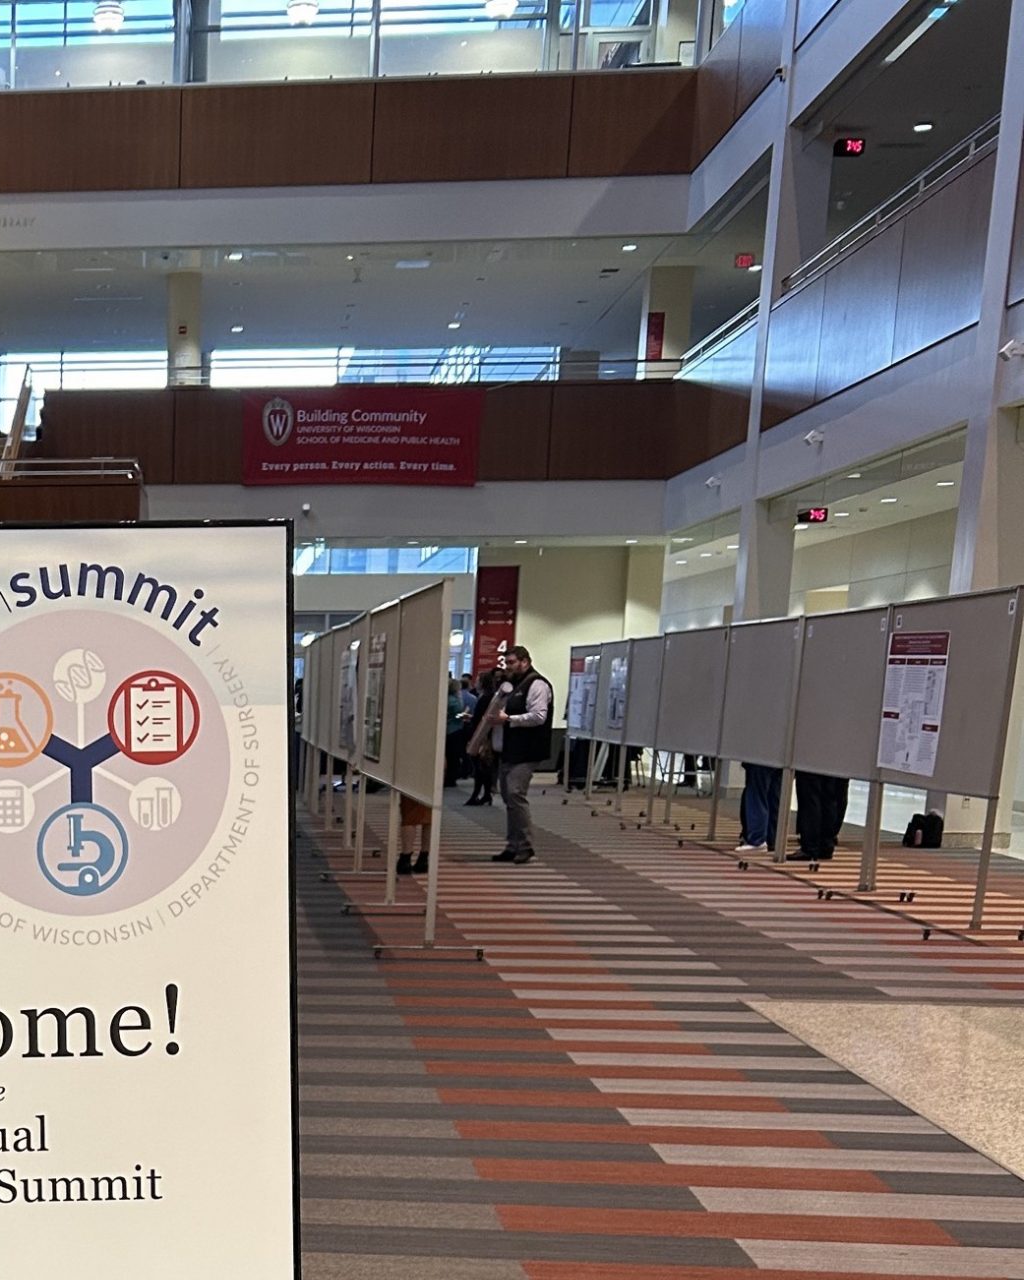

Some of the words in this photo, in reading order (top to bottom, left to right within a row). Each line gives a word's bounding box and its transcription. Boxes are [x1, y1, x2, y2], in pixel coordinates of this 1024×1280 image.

[296, 409, 349, 424] Building
[352, 409, 428, 424] Community
[296, 425, 342, 434] UNIVERSITY
[343, 425, 355, 434] OF
[356, 425, 401, 434] WISCONSIN
[296, 436, 328, 445] SCHOOL
[330, 436, 341, 445] OF
[342, 436, 380, 445] MEDICINE
[381, 436, 400, 445] AND
[401, 436, 428, 445] PUBLIC
[429, 436, 461, 446] HEALTH
[261, 461, 291, 472] Every
[331, 460, 361, 471] Every
[399, 461, 428, 472] Every
[497, 640, 507, 652] 4
[212, 658, 260, 750] SURGERY
[243, 757, 260, 786] OF
[167, 793, 257, 918] DEPARTMENT
[32, 916, 154, 946] WISCONSIN
